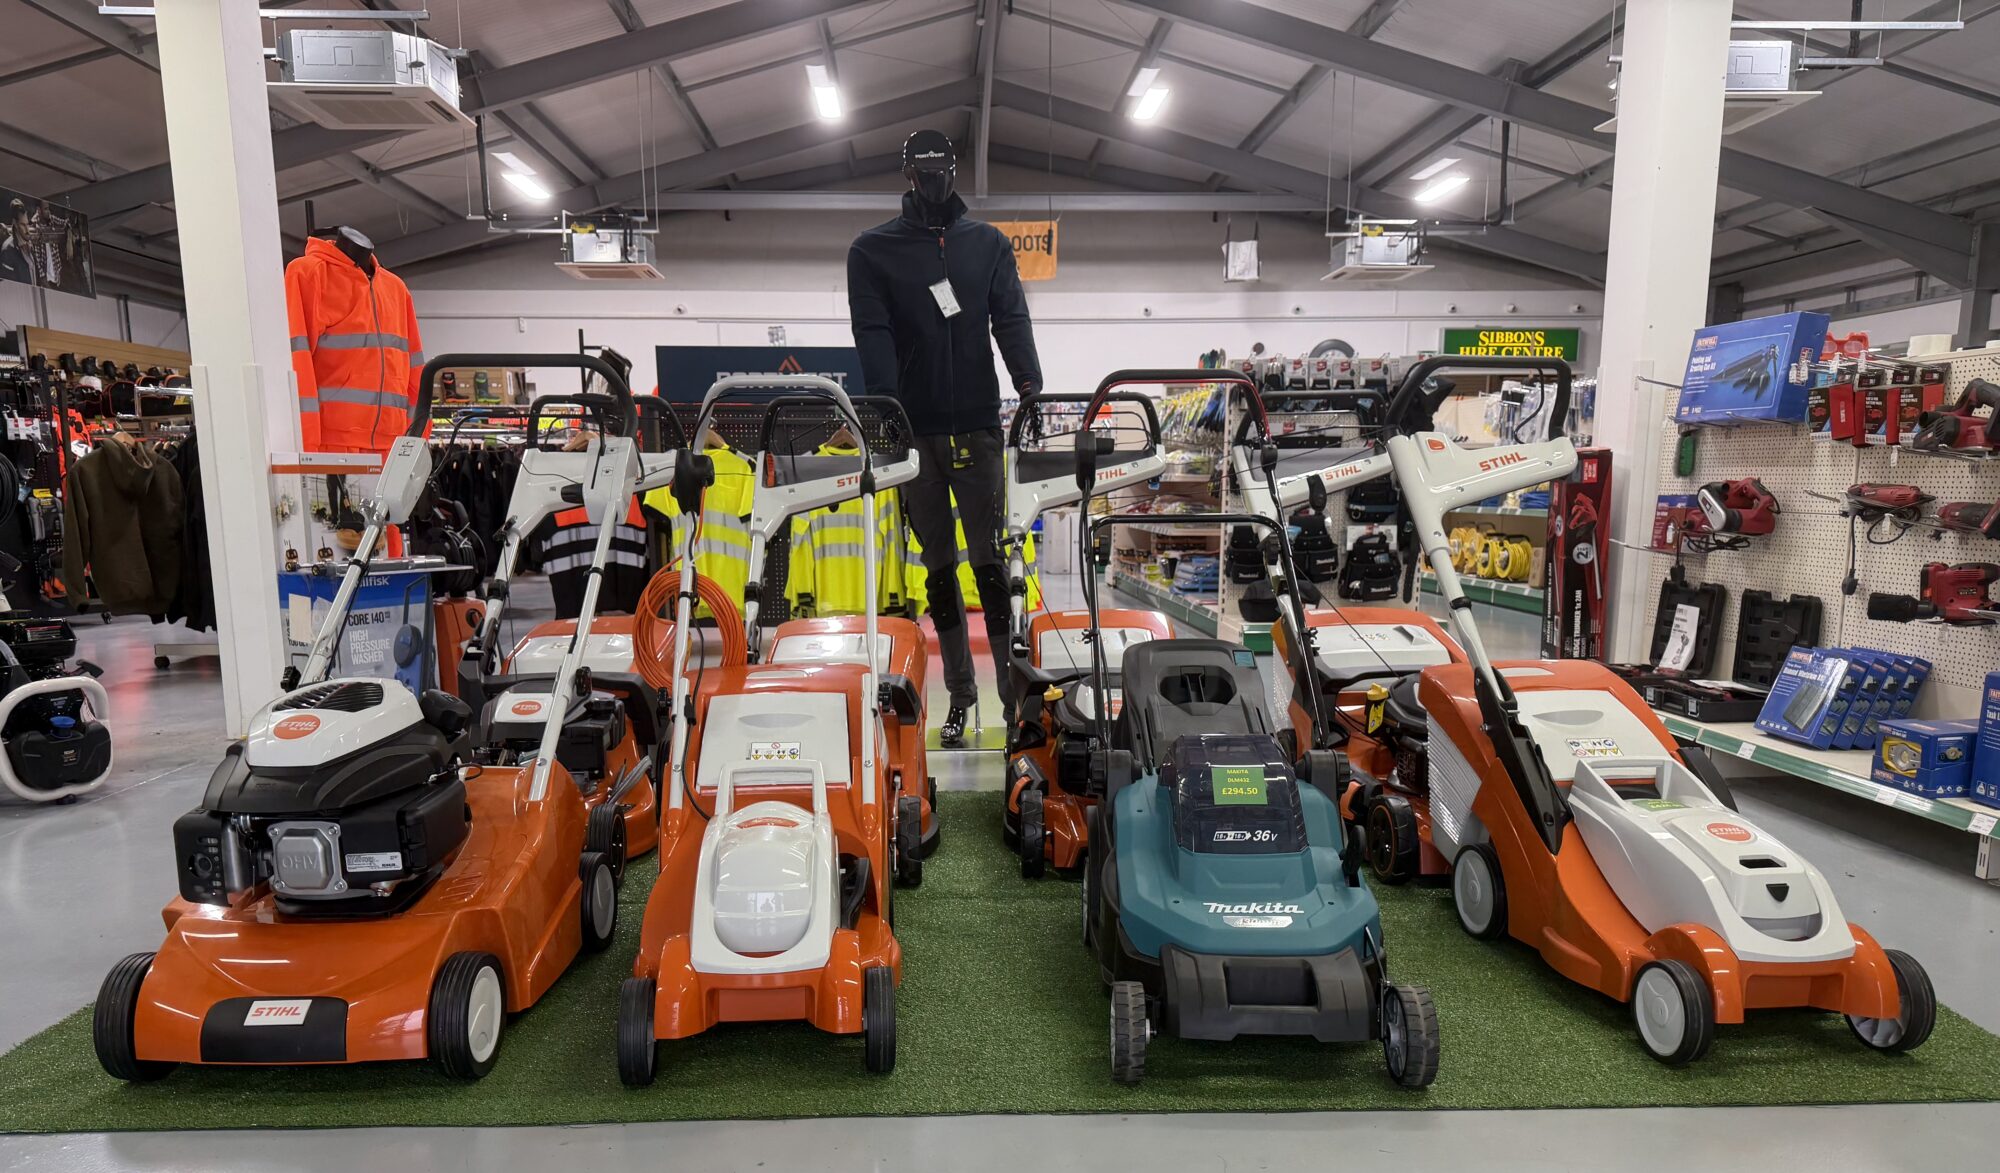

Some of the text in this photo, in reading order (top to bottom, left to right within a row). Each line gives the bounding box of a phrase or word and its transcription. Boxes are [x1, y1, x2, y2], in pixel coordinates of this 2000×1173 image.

[1011, 234, 1050, 252] OOTS
[1478, 330, 1545, 347] SIBBONS
[1459, 346, 1564, 359] HIRE CENTRE
[1479, 452, 1528, 472] STIHL
[1097, 468, 1128, 481] TIHL
[1325, 465, 1362, 480] STIHL
[348, 612, 370, 627] CORE
[1574, 610, 1582, 638] TRIMMER
[349, 629, 369, 642] HIGH
[350, 639, 391, 654] PRESSURE
[351, 652, 384, 666] WASHER
[278, 718, 318, 728] STIHL
[1221, 787, 1258, 796] £294.50
[251, 1006, 302, 1017] STIHL
